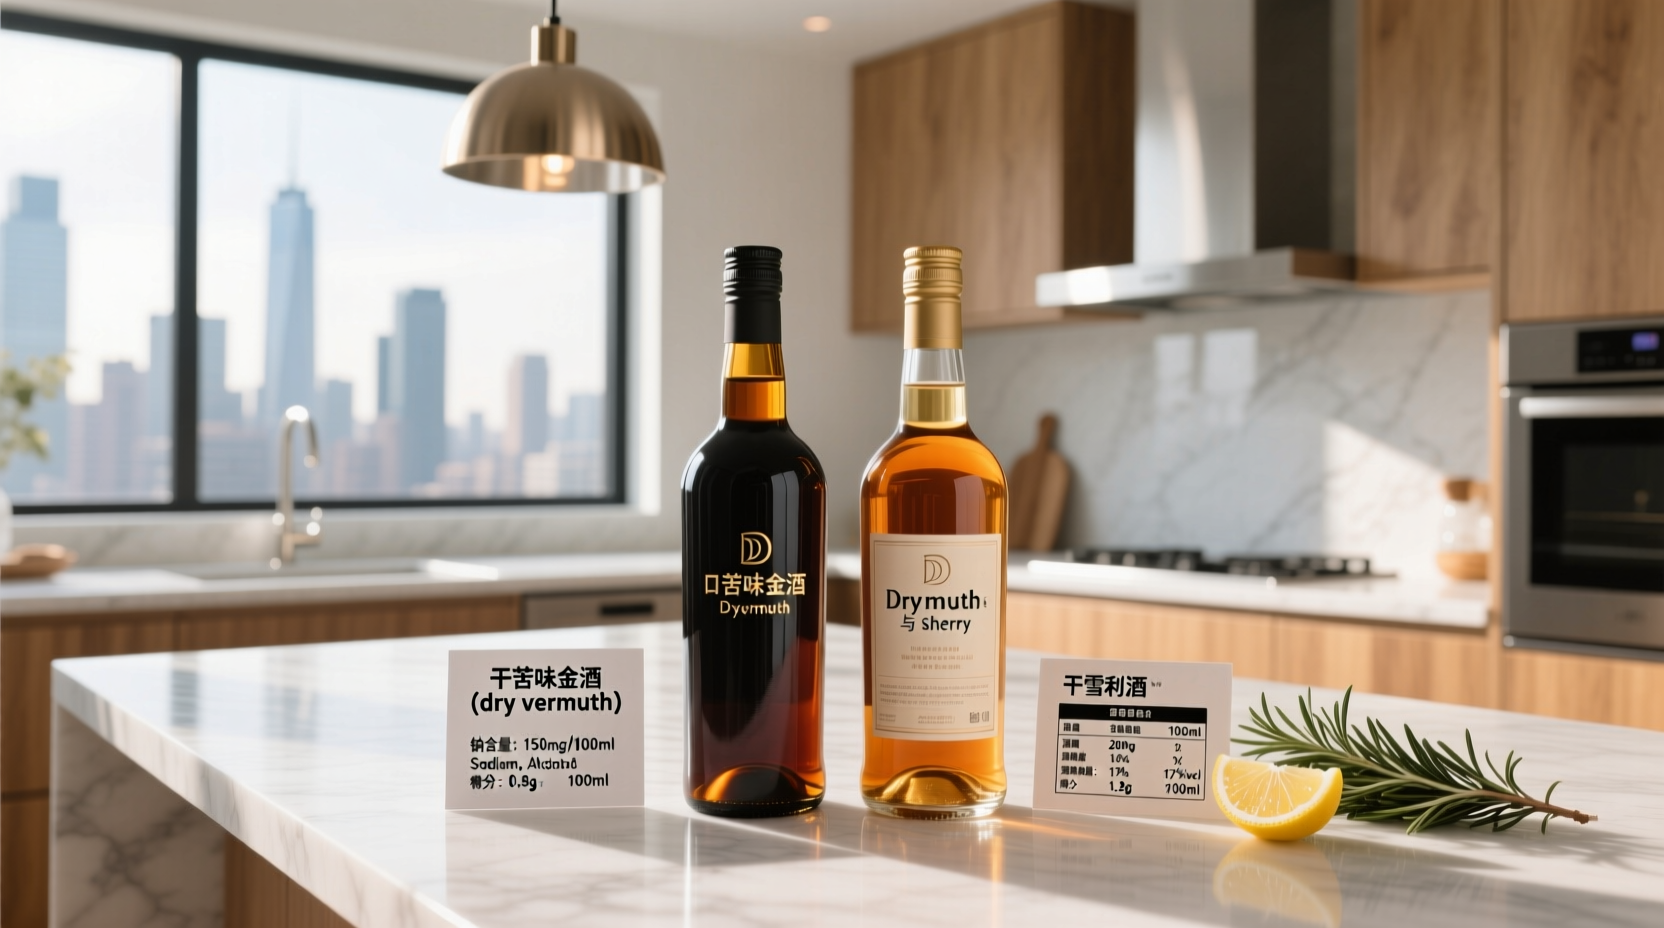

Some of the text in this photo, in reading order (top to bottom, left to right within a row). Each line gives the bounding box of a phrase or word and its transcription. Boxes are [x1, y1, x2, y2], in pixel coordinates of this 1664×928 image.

[490, 665, 602, 689] 干苦味金酒
[1063, 674, 1148, 698] 干雪利酒
[471, 690, 622, 717] (dry vermuth)
[1168, 726, 1201, 737] 100ml
[524, 735, 615, 754] 150mg/100ml
[568, 773, 608, 787] 100ml
